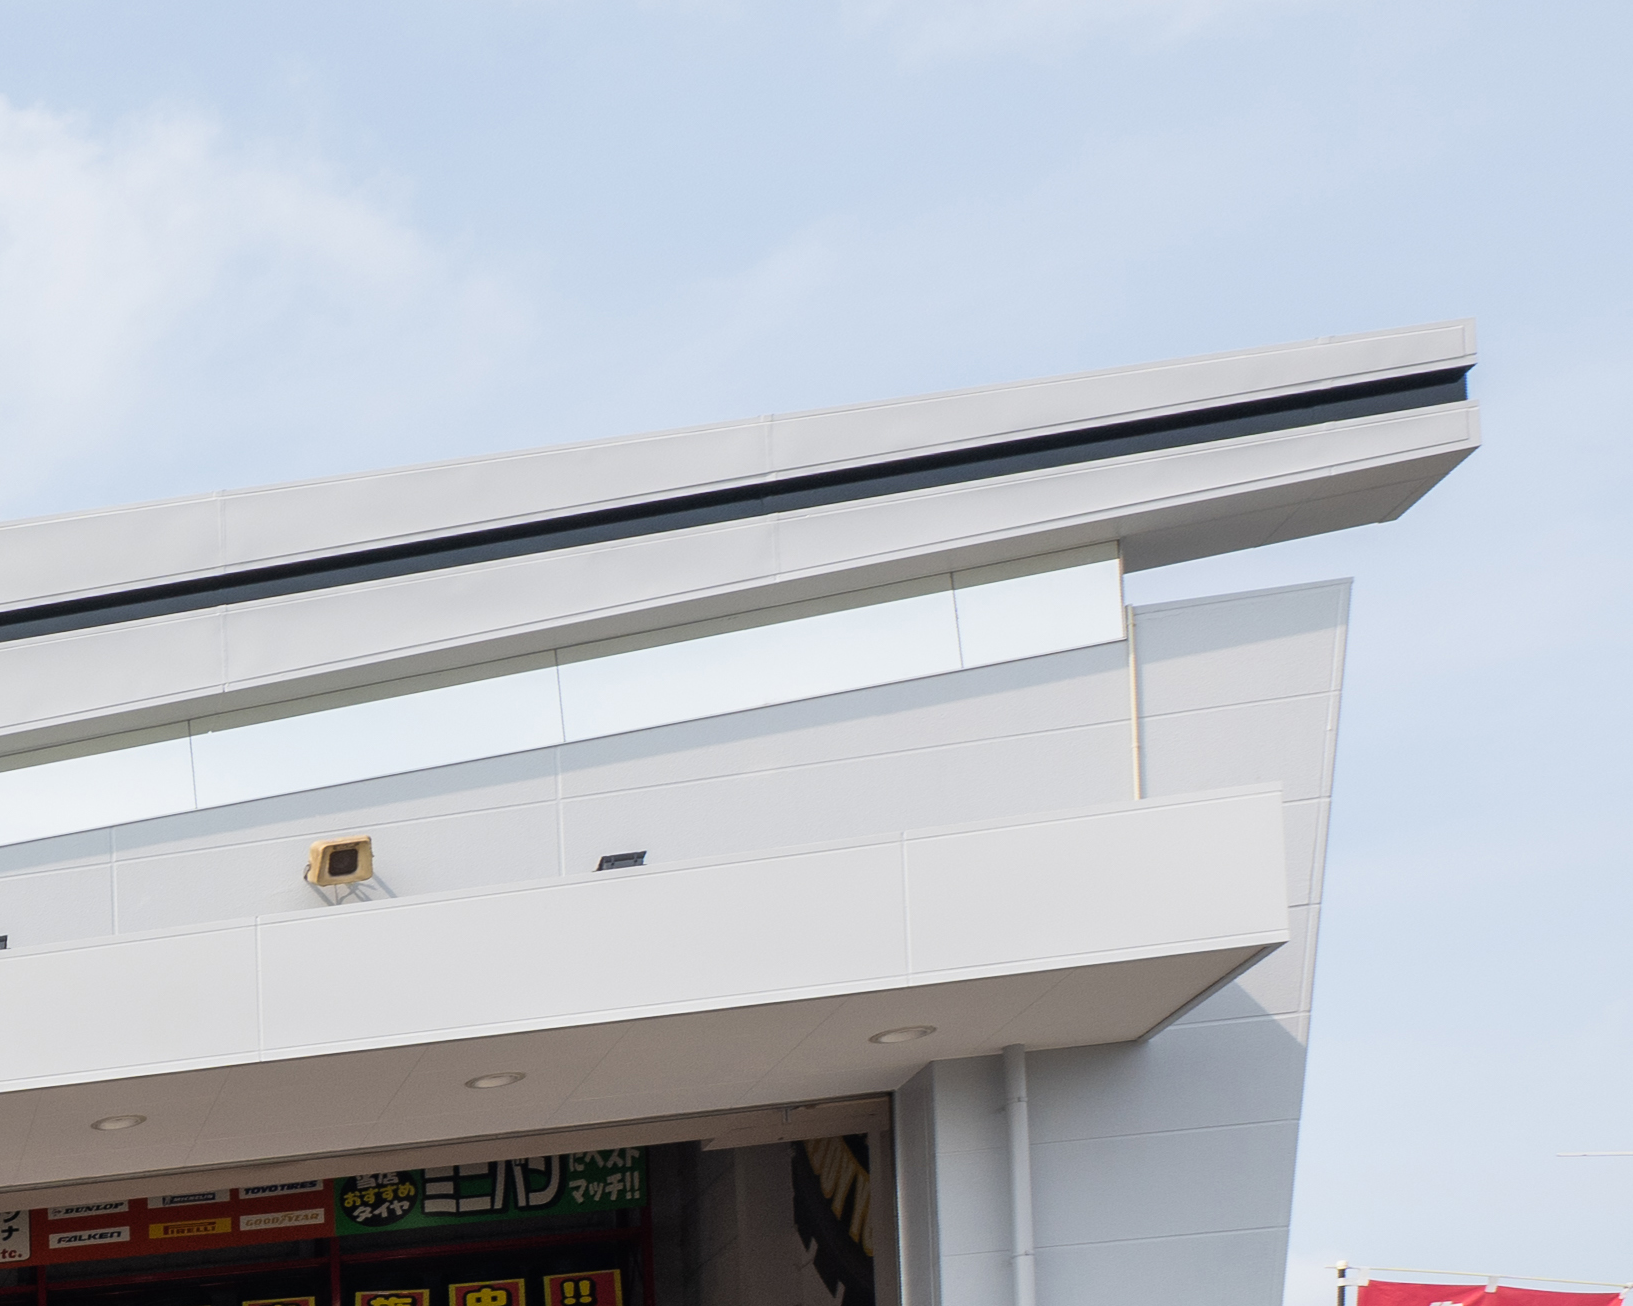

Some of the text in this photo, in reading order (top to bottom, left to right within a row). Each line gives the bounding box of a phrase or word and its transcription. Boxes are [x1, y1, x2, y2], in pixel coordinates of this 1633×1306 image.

[344, 1182, 415, 1207] おすすめ
[353, 1201, 410, 1222] タイヤ
[57, 1230, 122, 1244] FALKEN
